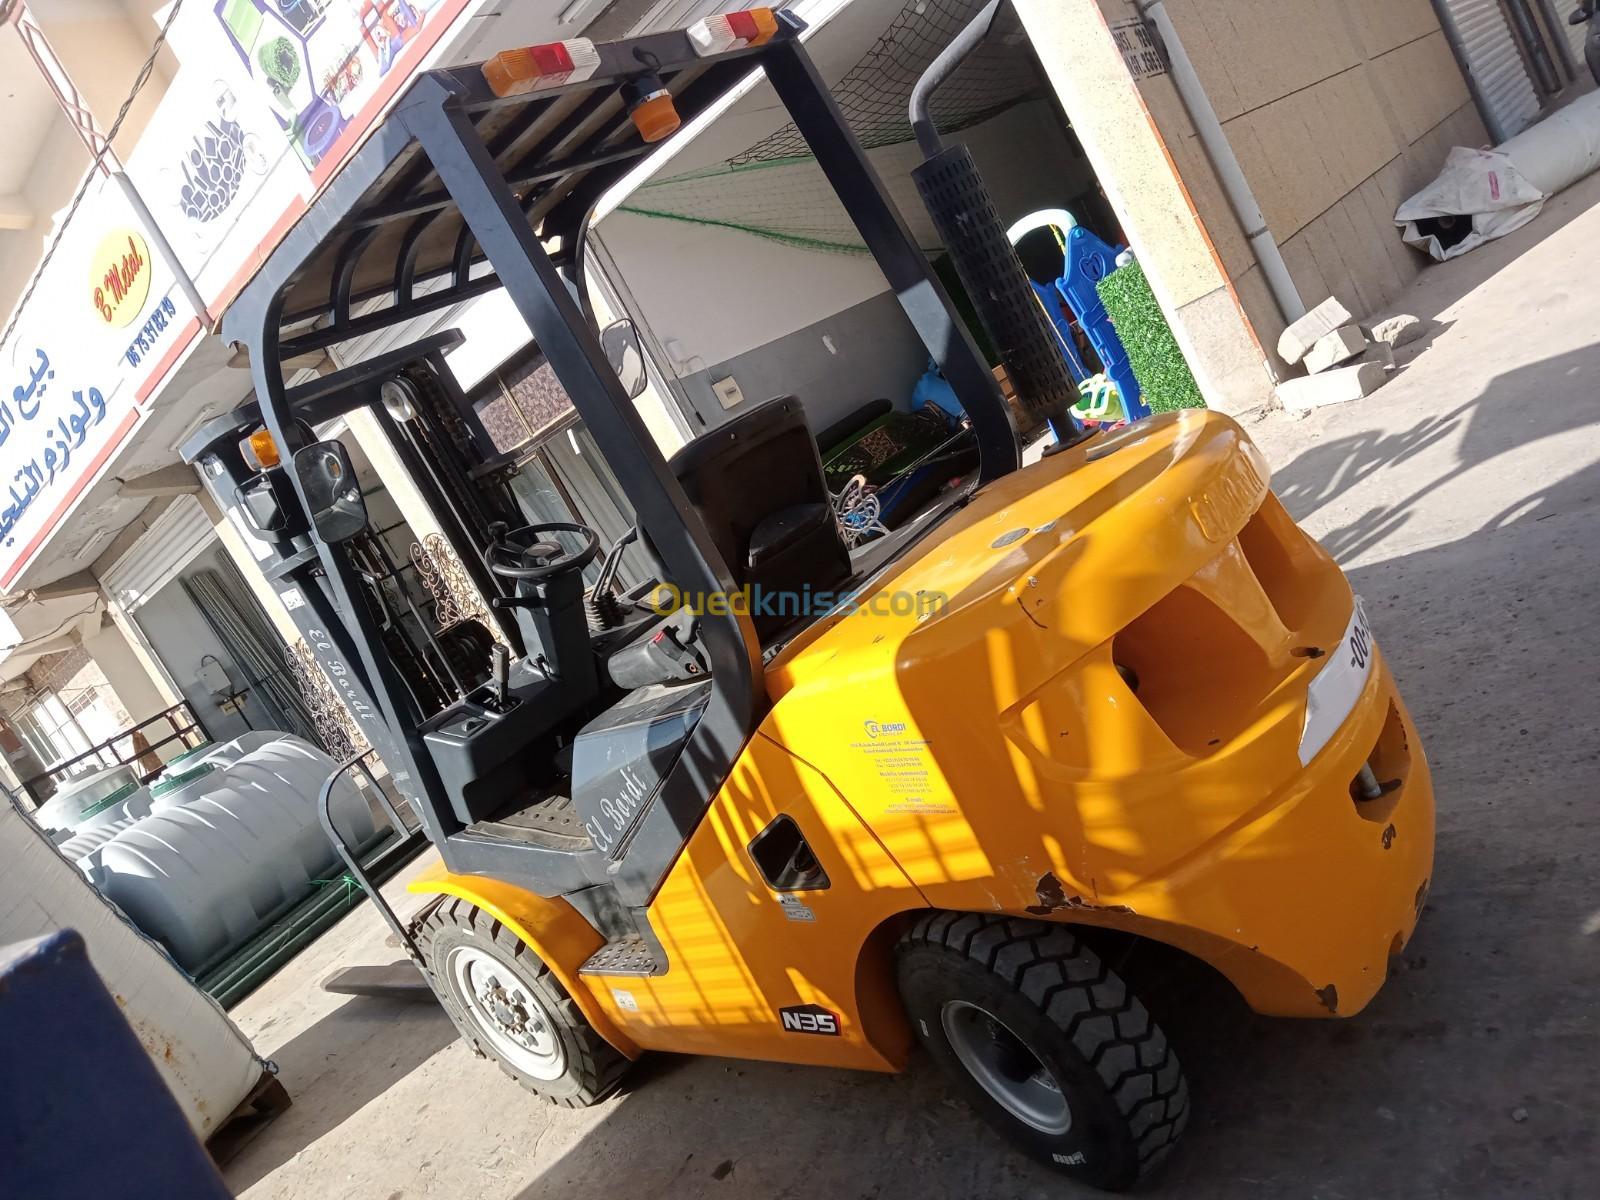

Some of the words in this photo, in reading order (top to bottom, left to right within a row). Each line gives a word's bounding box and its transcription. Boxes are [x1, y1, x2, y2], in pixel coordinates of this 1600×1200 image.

[13, 348, 55, 421] بيع
[44, 387, 106, 486] ولوازم
[0, 458, 44, 547] التلحي
[308, 629, 331, 651] El
[585, 815, 613, 852] El
[600, 765, 647, 831] Bordi
[782, 1011, 836, 1033] N35
